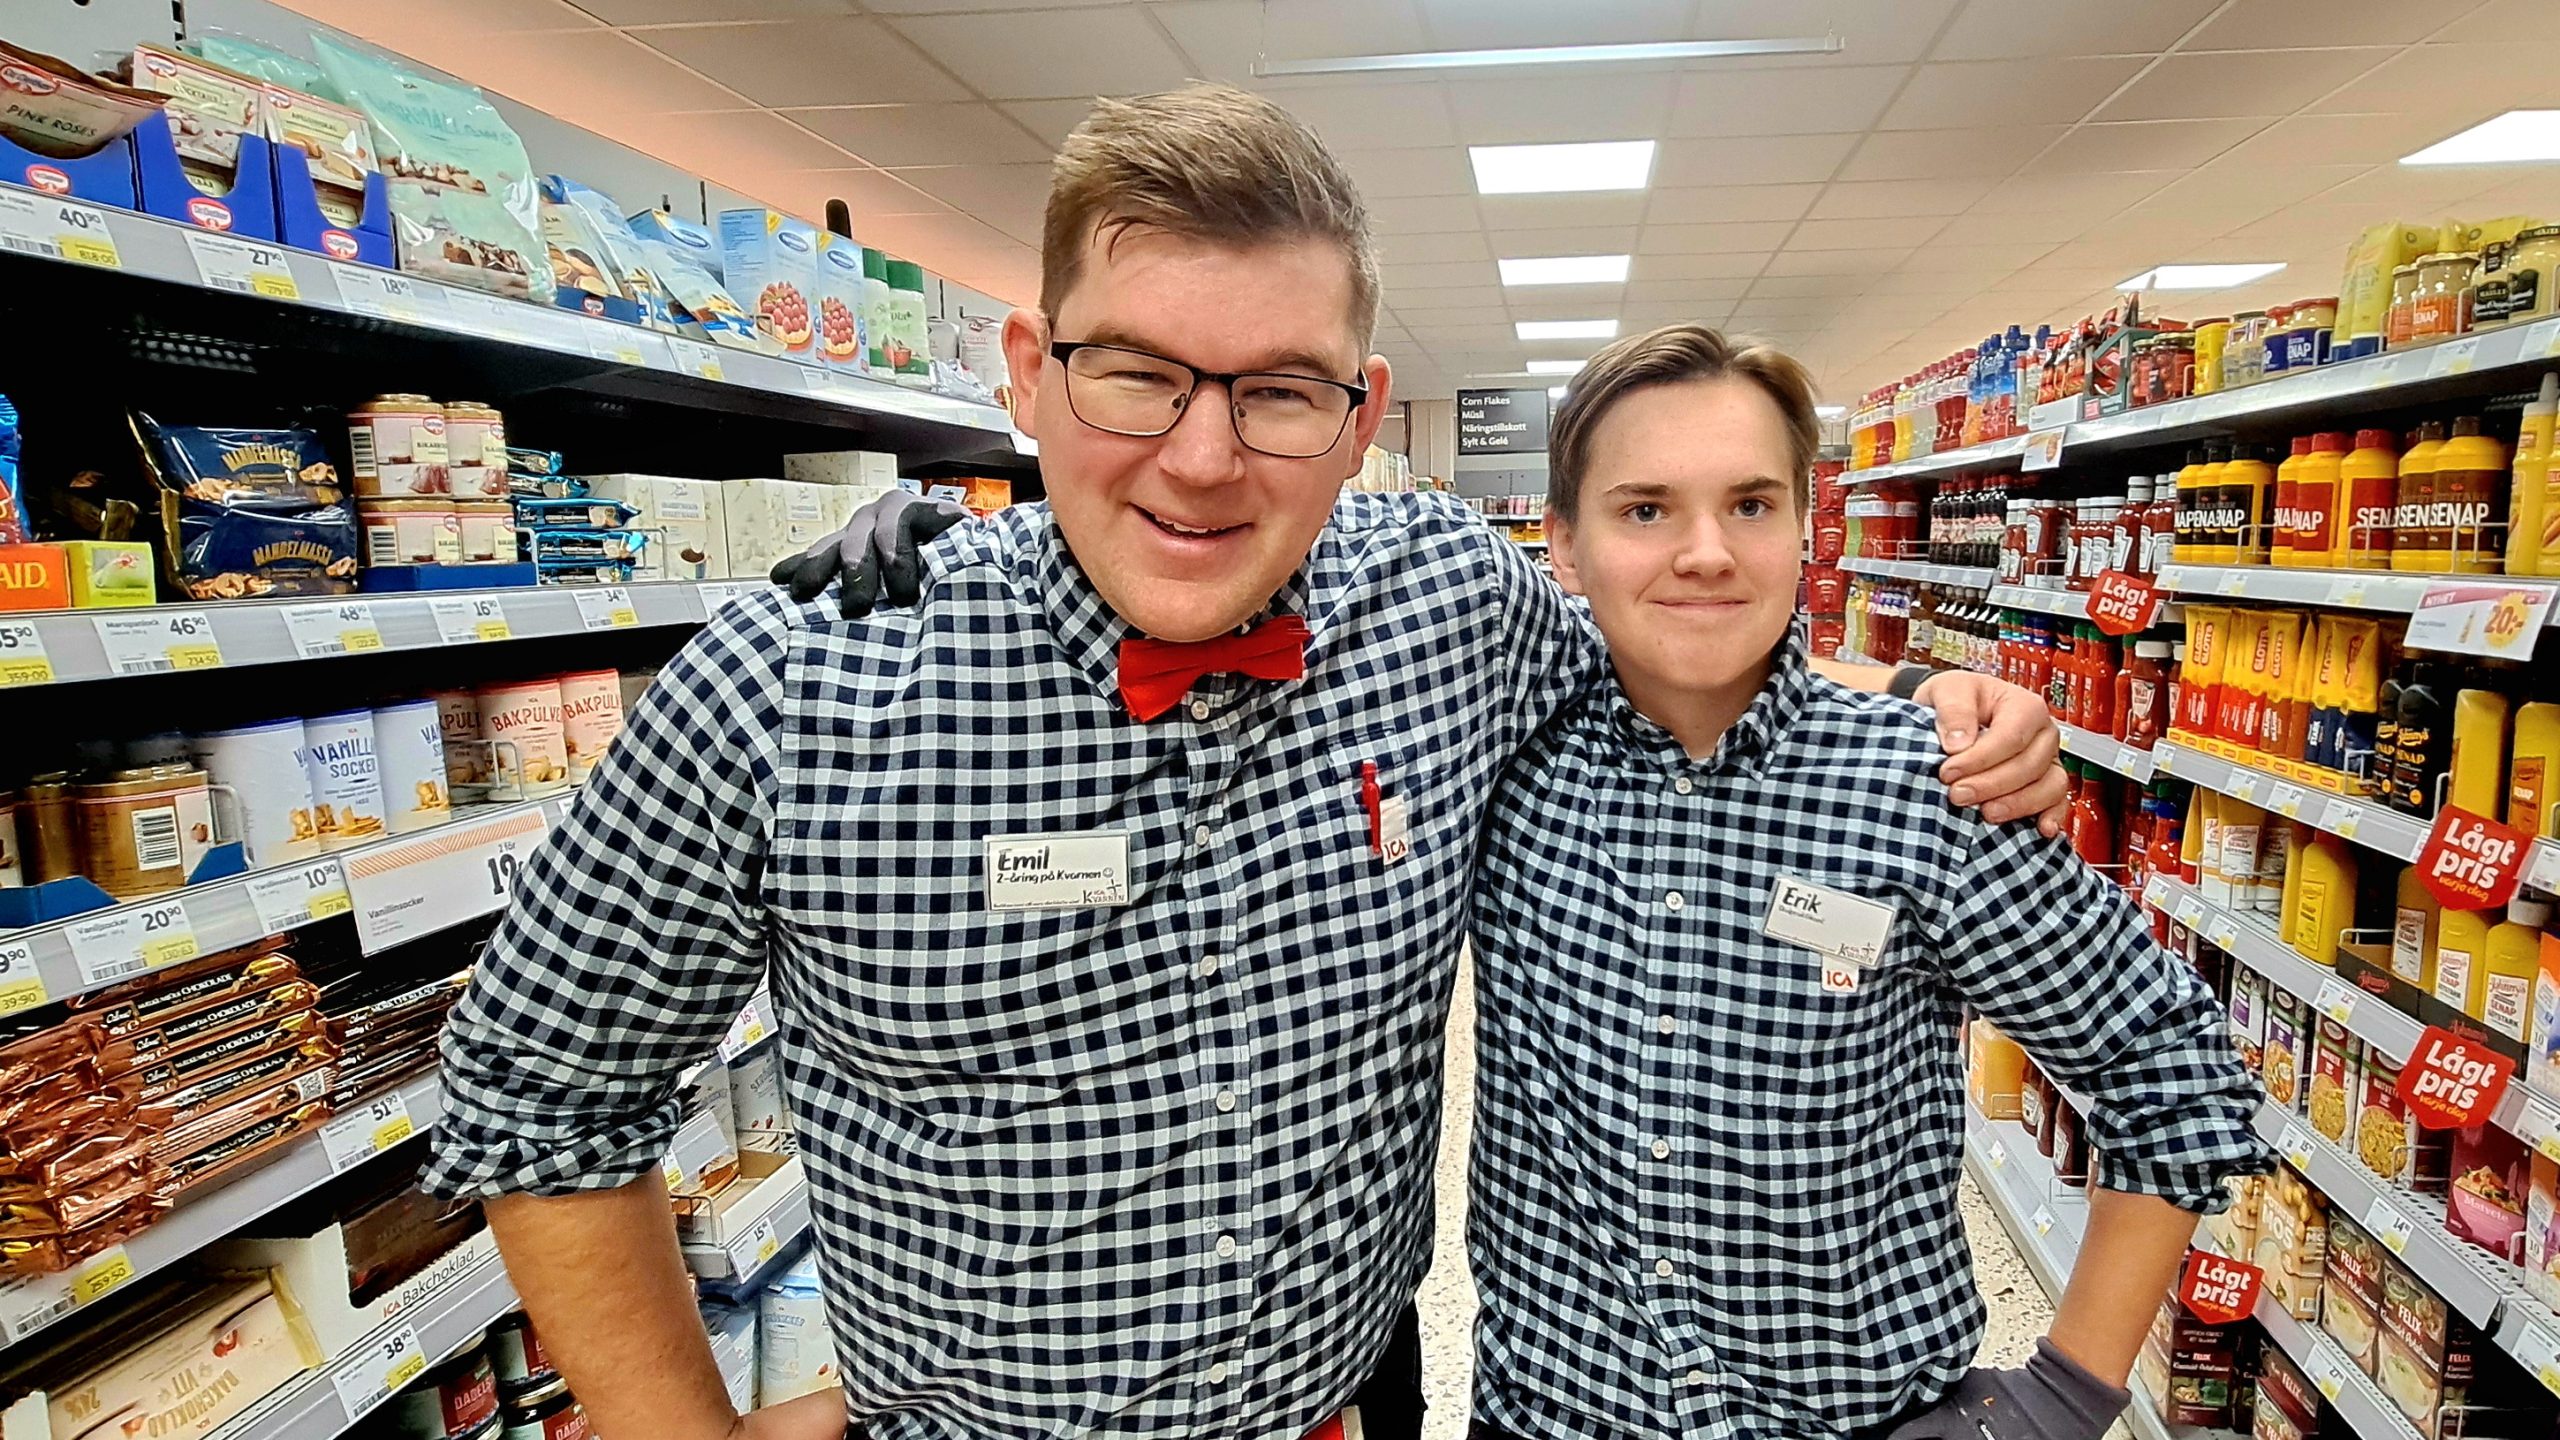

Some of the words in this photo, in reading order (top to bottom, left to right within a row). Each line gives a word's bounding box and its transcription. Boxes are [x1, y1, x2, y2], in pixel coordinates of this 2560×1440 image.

[6, 104, 47, 124] PINK
[51, 118, 98, 138] ROSES
[1461, 397, 1483, 406] Corn
[1484, 396, 1511, 405] Flakes
[1461, 422, 1528, 434] Näringstillskott
[1461, 437, 1480, 447] Sylt
[1480, 437, 1488, 446] &
[1488, 436, 1509, 446] Gelé
[2430, 503, 2489, 527] SENAP
[2102, 576, 2149, 606] Lågt
[2095, 597, 2139, 621] pris
[1384, 838, 1407, 860] ICA
[2443, 817, 2516, 866] Lågt
[997, 845, 1051, 872] Emil
[2431, 848, 2499, 889] pris
[996, 871, 1039, 885] 2-åring
[1040, 870, 1056, 884] på
[1056, 868, 1101, 881] Kvarnen
[1782, 886, 1823, 915] Erik
[2466, 884, 2489, 903] dag
[366, 895, 426, 921] Vanillinsocker
[1826, 970, 1854, 989] ICA
[2490, 999, 2517, 1016] SENAP
[2425, 1039, 2497, 1088] Lågt
[2412, 1069, 2479, 1109] pris
[2446, 1104, 2468, 1123] dag
[2463, 1194, 2510, 1223] Matvete
[2197, 1258, 2252, 1291] Lågt
[2339, 1249, 2363, 1278] FELIX
[383, 1301, 402, 1319] ICA
[401, 1246, 476, 1307] Bakchoklad
[2191, 1281, 2242, 1308] pris
[2398, 1304, 2423, 1336] FELIX
